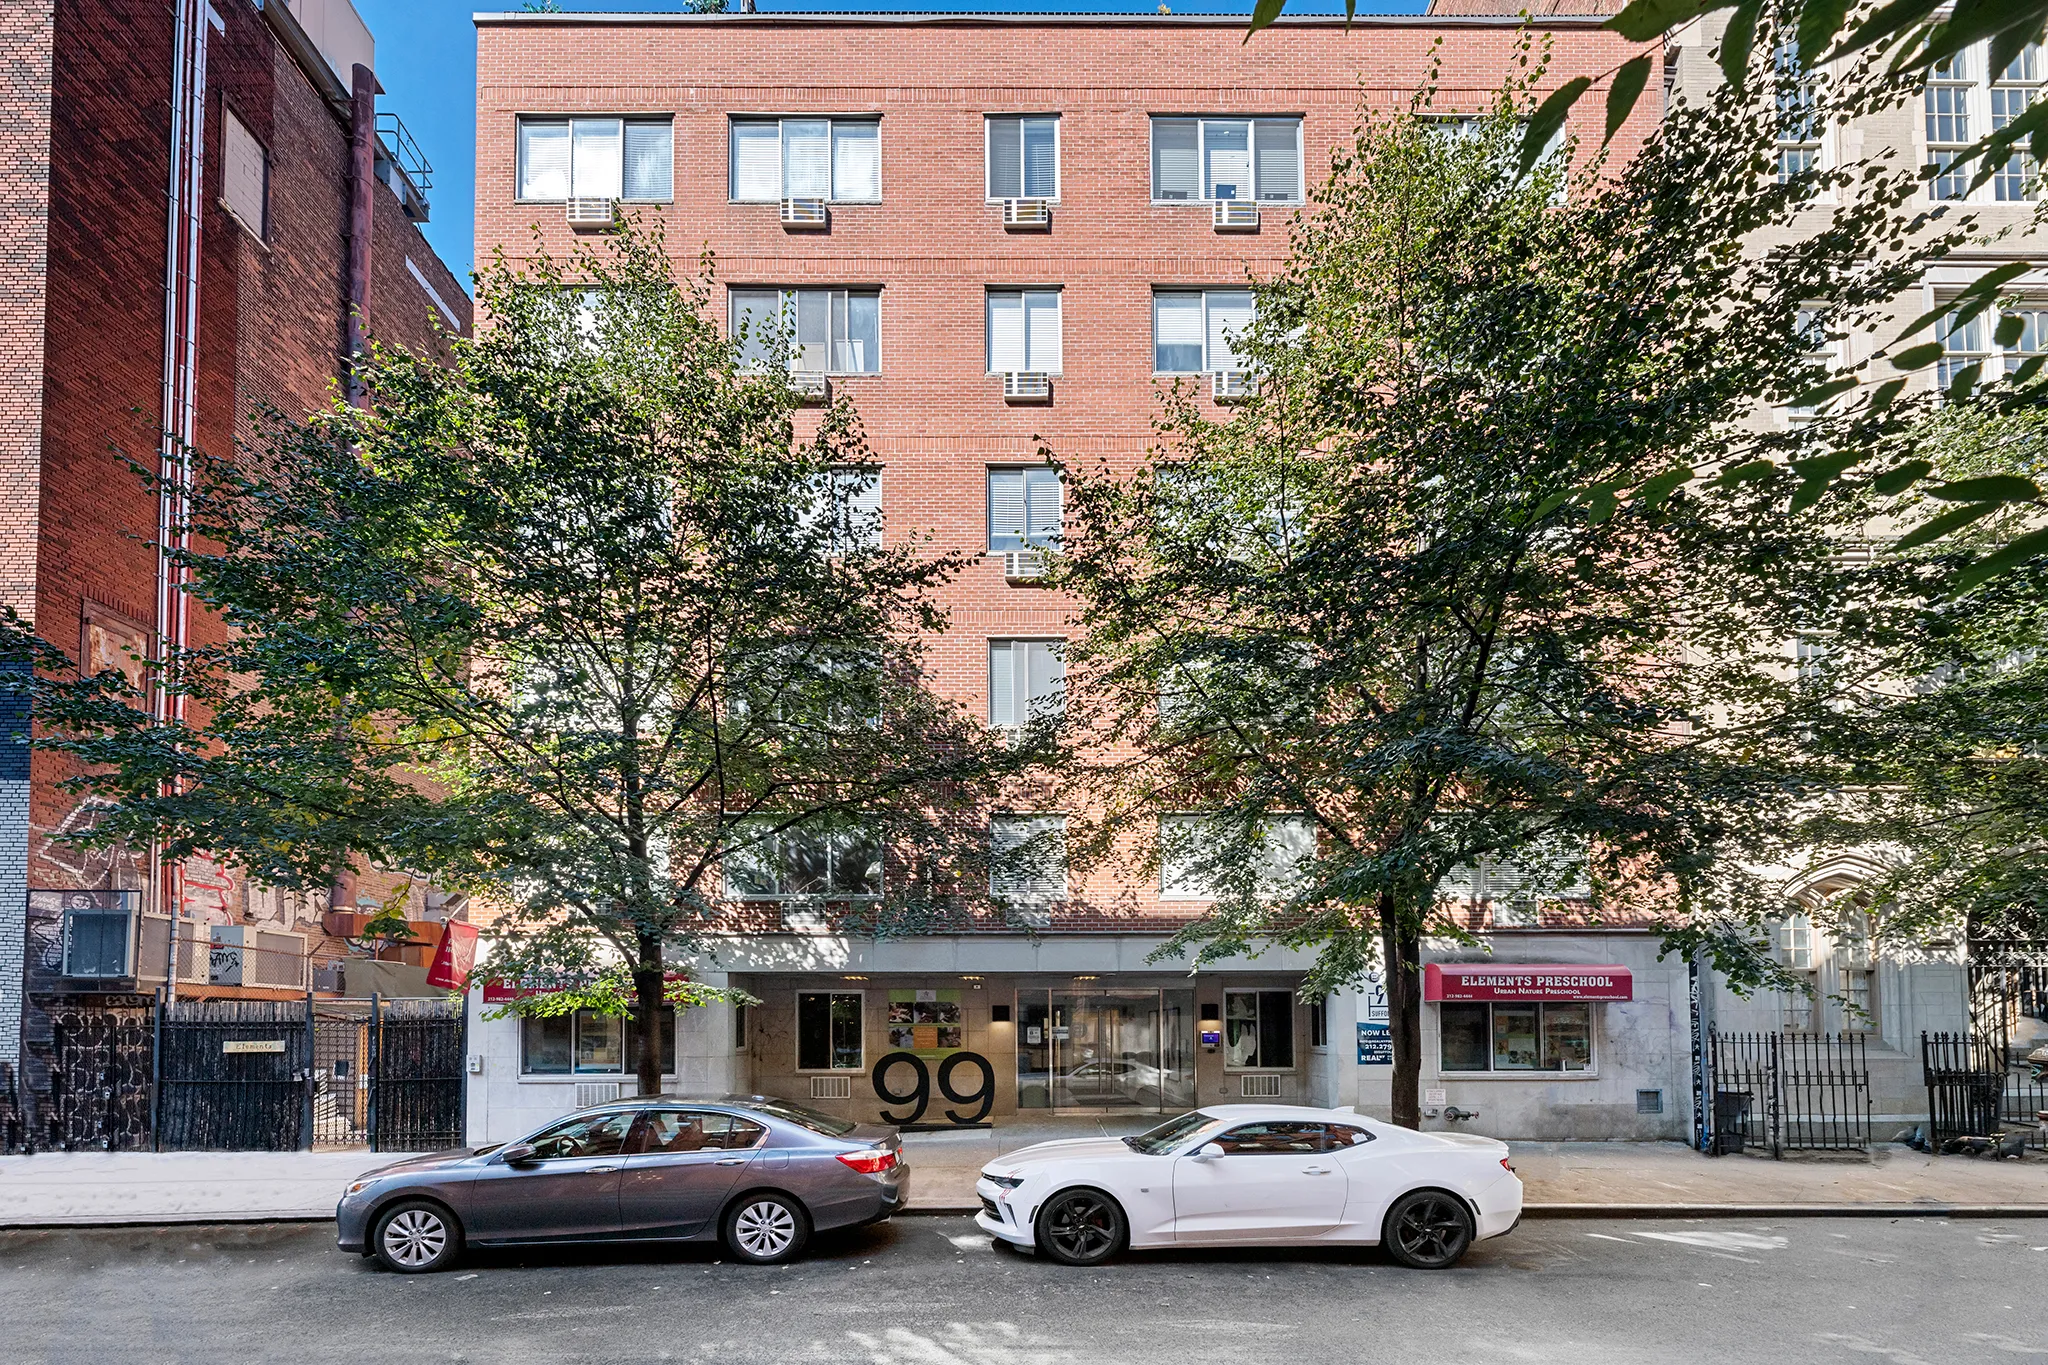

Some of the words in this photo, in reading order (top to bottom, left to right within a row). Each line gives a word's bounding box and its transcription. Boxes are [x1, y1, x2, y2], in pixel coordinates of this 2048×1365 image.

[1461, 975, 1532, 987] ELEMENTS
[1536, 975, 1613, 987] PRESCHOOL
[872, 1051, 995, 1125] 99
